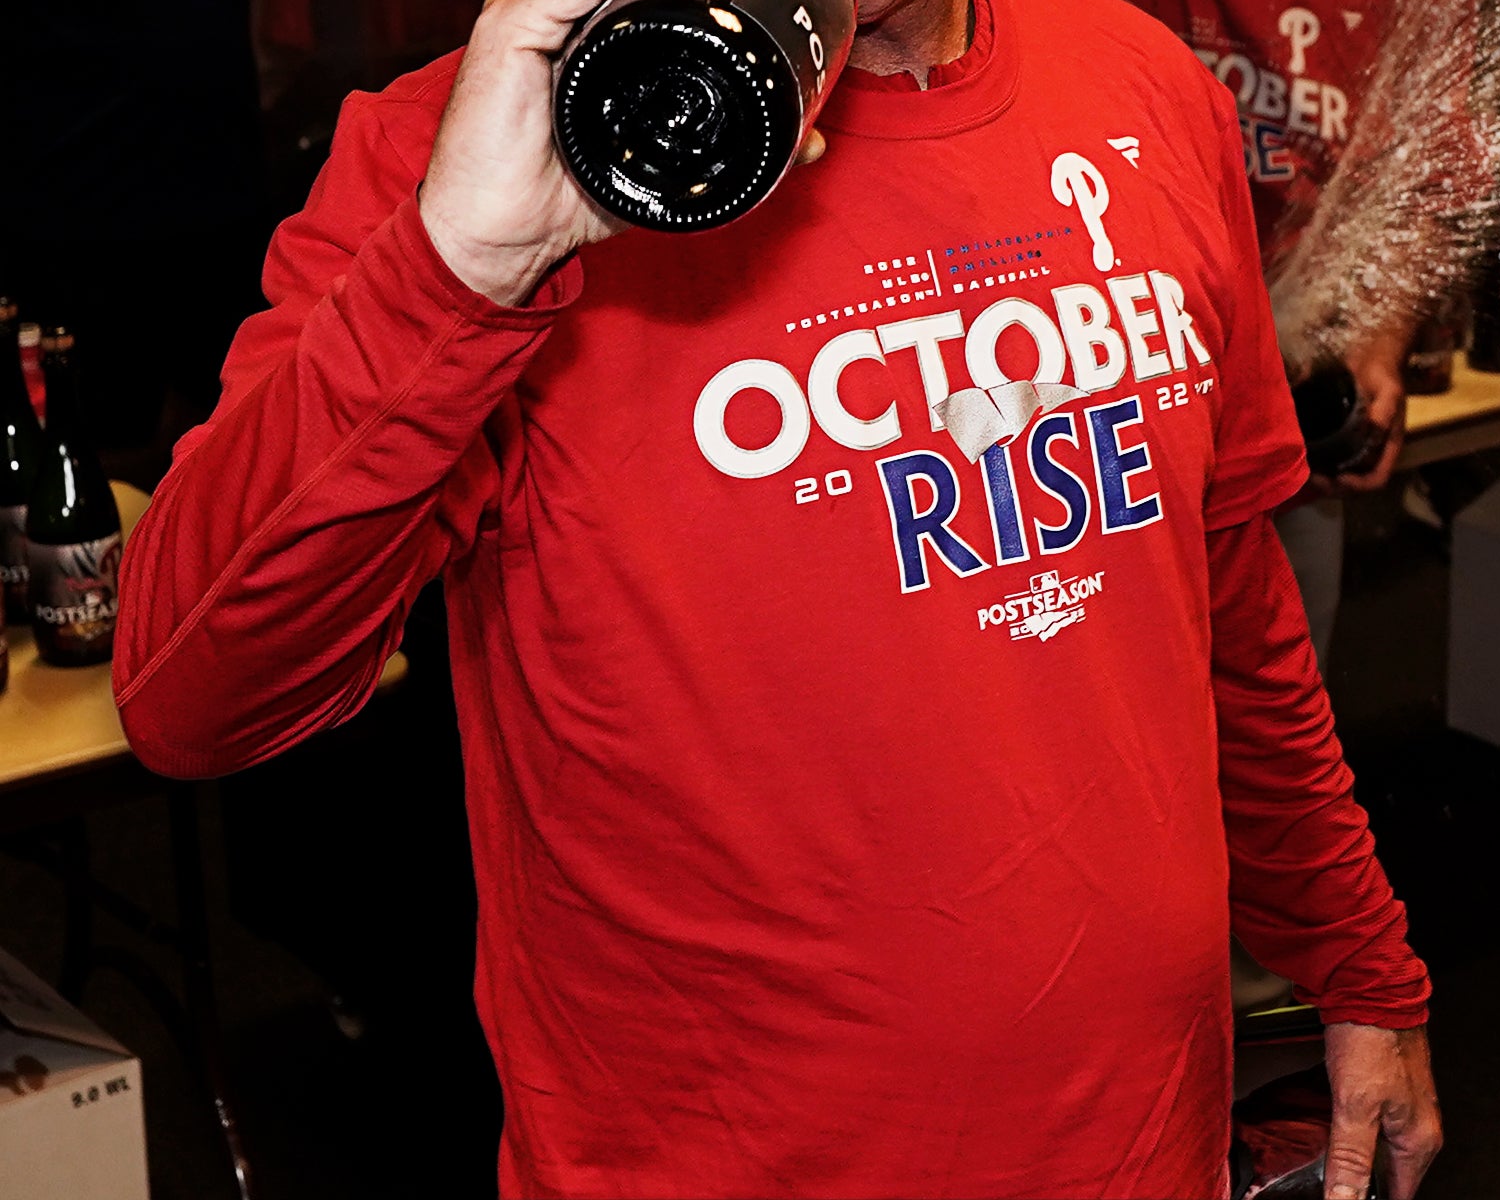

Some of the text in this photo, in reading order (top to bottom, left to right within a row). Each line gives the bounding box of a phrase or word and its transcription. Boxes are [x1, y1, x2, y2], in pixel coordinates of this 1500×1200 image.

[1278, 6, 1321, 75] P
[1050, 152, 1114, 272] P
[692, 270, 1212, 480] OCTOBER
[1155, 382, 1189, 411] 22
[794, 469, 853, 505] 20
[875, 394, 1164, 595] RISE
[976, 575, 1102, 631] POSTSEASON
